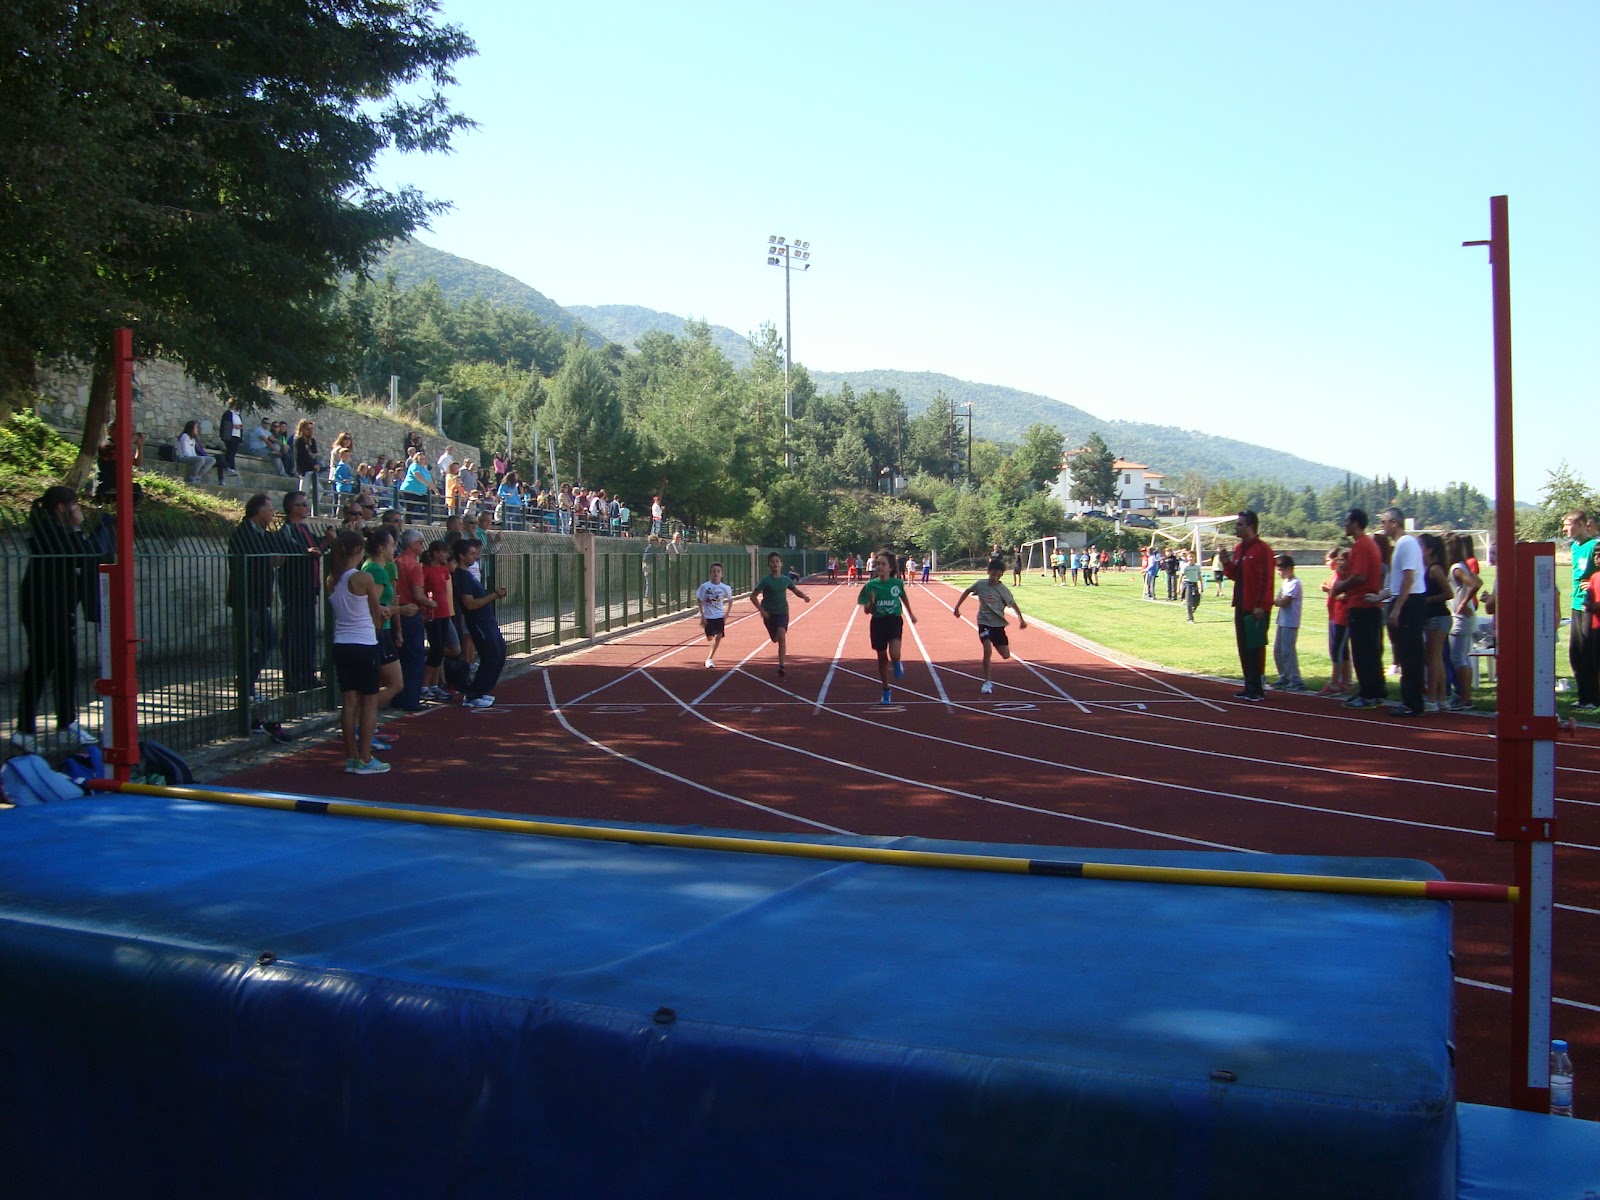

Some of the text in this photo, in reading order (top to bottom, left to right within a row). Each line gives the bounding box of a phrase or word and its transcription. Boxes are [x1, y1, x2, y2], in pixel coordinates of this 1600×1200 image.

[589, 705, 647, 714] 5
[719, 705, 776, 714] 4
[862, 704, 907, 714] 3
[992, 702, 1041, 711] 2
[1120, 702, 1148, 710] 1
